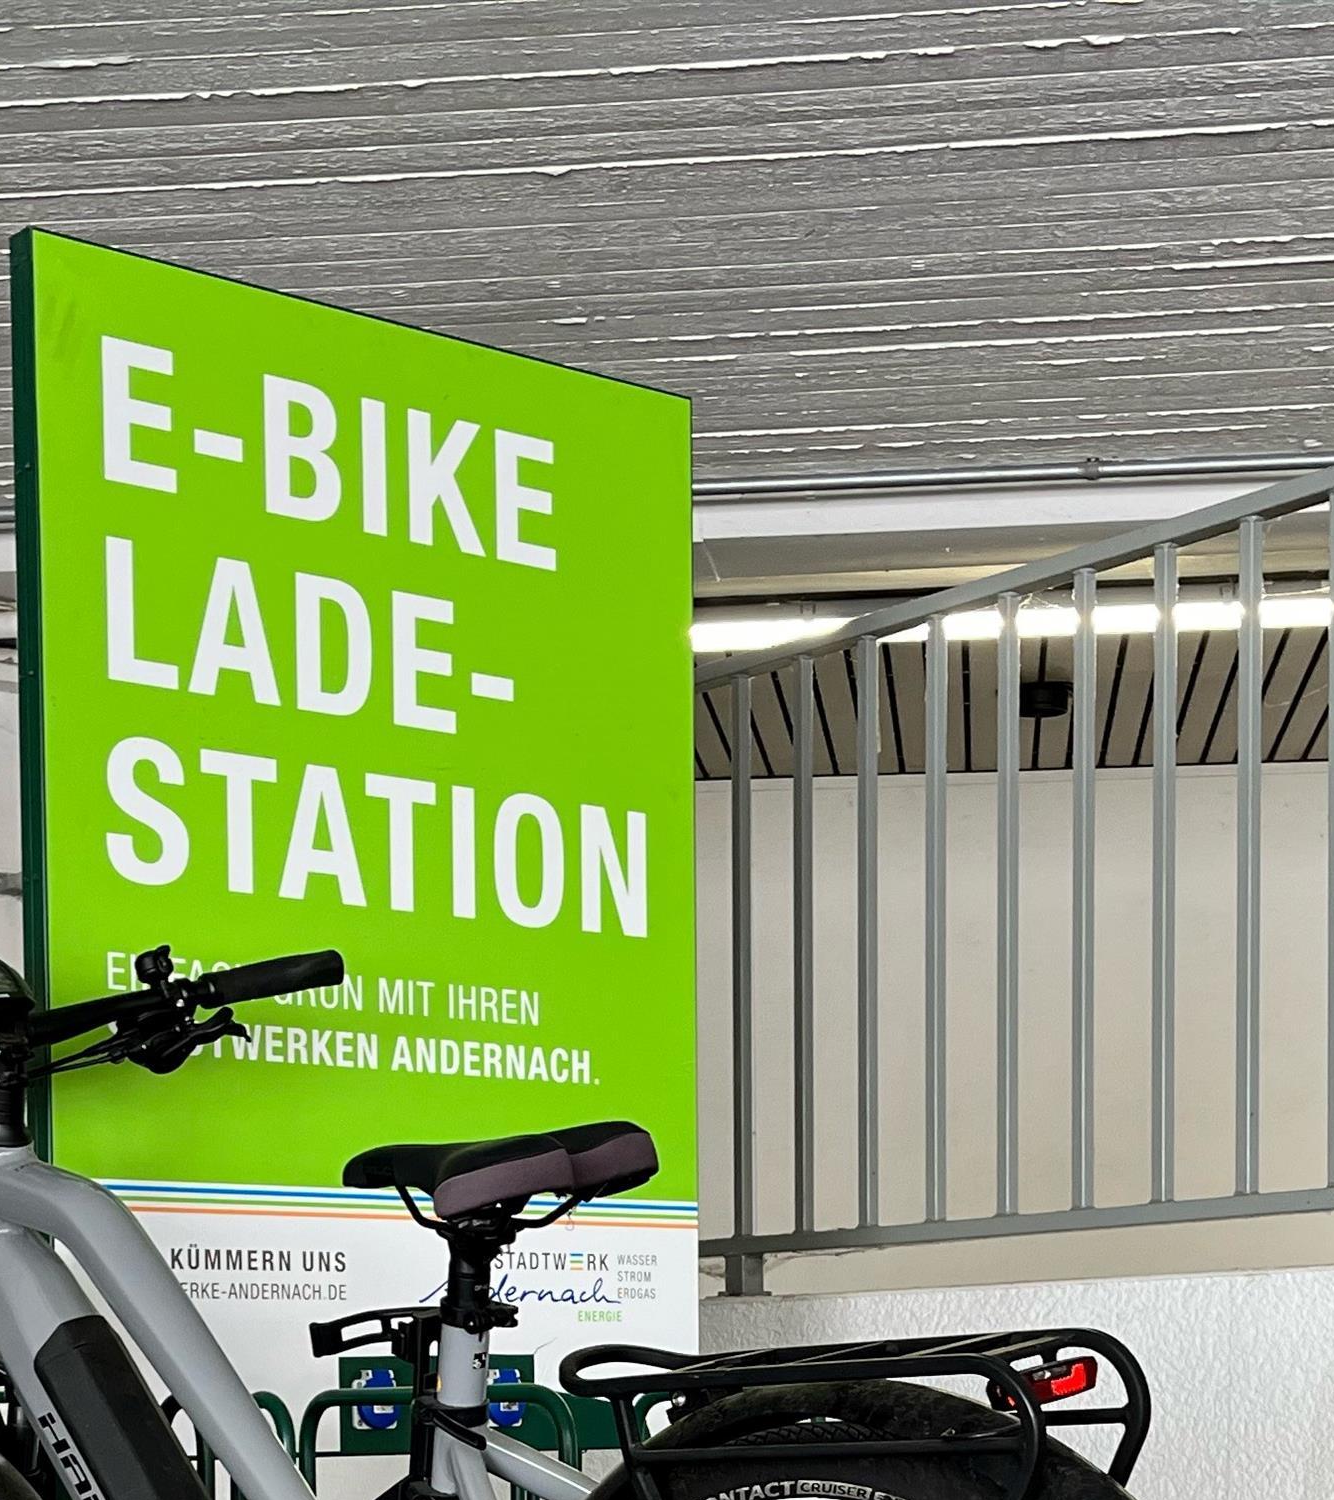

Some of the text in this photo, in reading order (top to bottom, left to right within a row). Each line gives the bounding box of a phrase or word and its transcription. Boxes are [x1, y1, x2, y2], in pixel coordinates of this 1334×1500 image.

[100, 335, 558, 572] E-BIKE
[104, 537, 515, 735] LADE-
[104, 736, 649, 939] STATION
[378, 977, 435, 1018] MIT
[448, 983, 540, 1026] IHREN
[391, 1035, 601, 1086] ANDERNACH.
[170, 1244, 347, 1273] KÜMMERN UNS
[617, 1254, 658, 1266] WASSER
[617, 1271, 652, 1283] STROM
[617, 1288, 656, 1299] ERDGAS
[577, 1310, 623, 1322] ENERGIE
[799, 1481, 870, 1500] CRUISER
